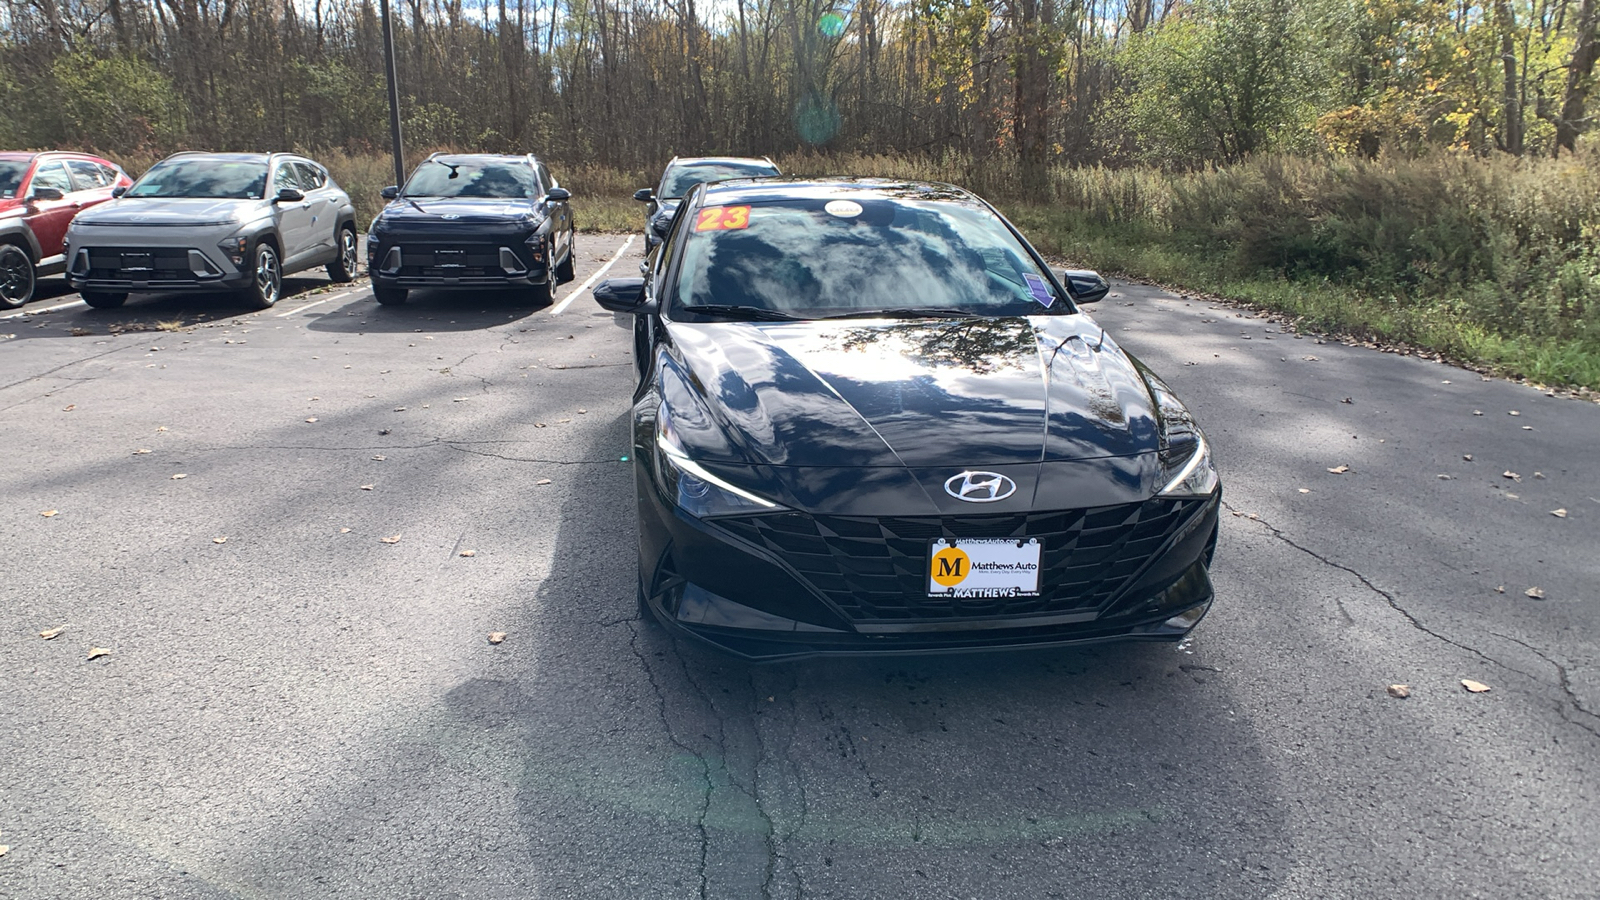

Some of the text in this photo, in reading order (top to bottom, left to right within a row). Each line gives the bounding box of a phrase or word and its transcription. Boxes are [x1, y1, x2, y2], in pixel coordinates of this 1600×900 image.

[698, 206, 747, 230] 23
[936, 557, 964, 577] M
[971, 561, 1037, 570] Matthews Auto
[953, 587, 1016, 598] MATTHEWS
